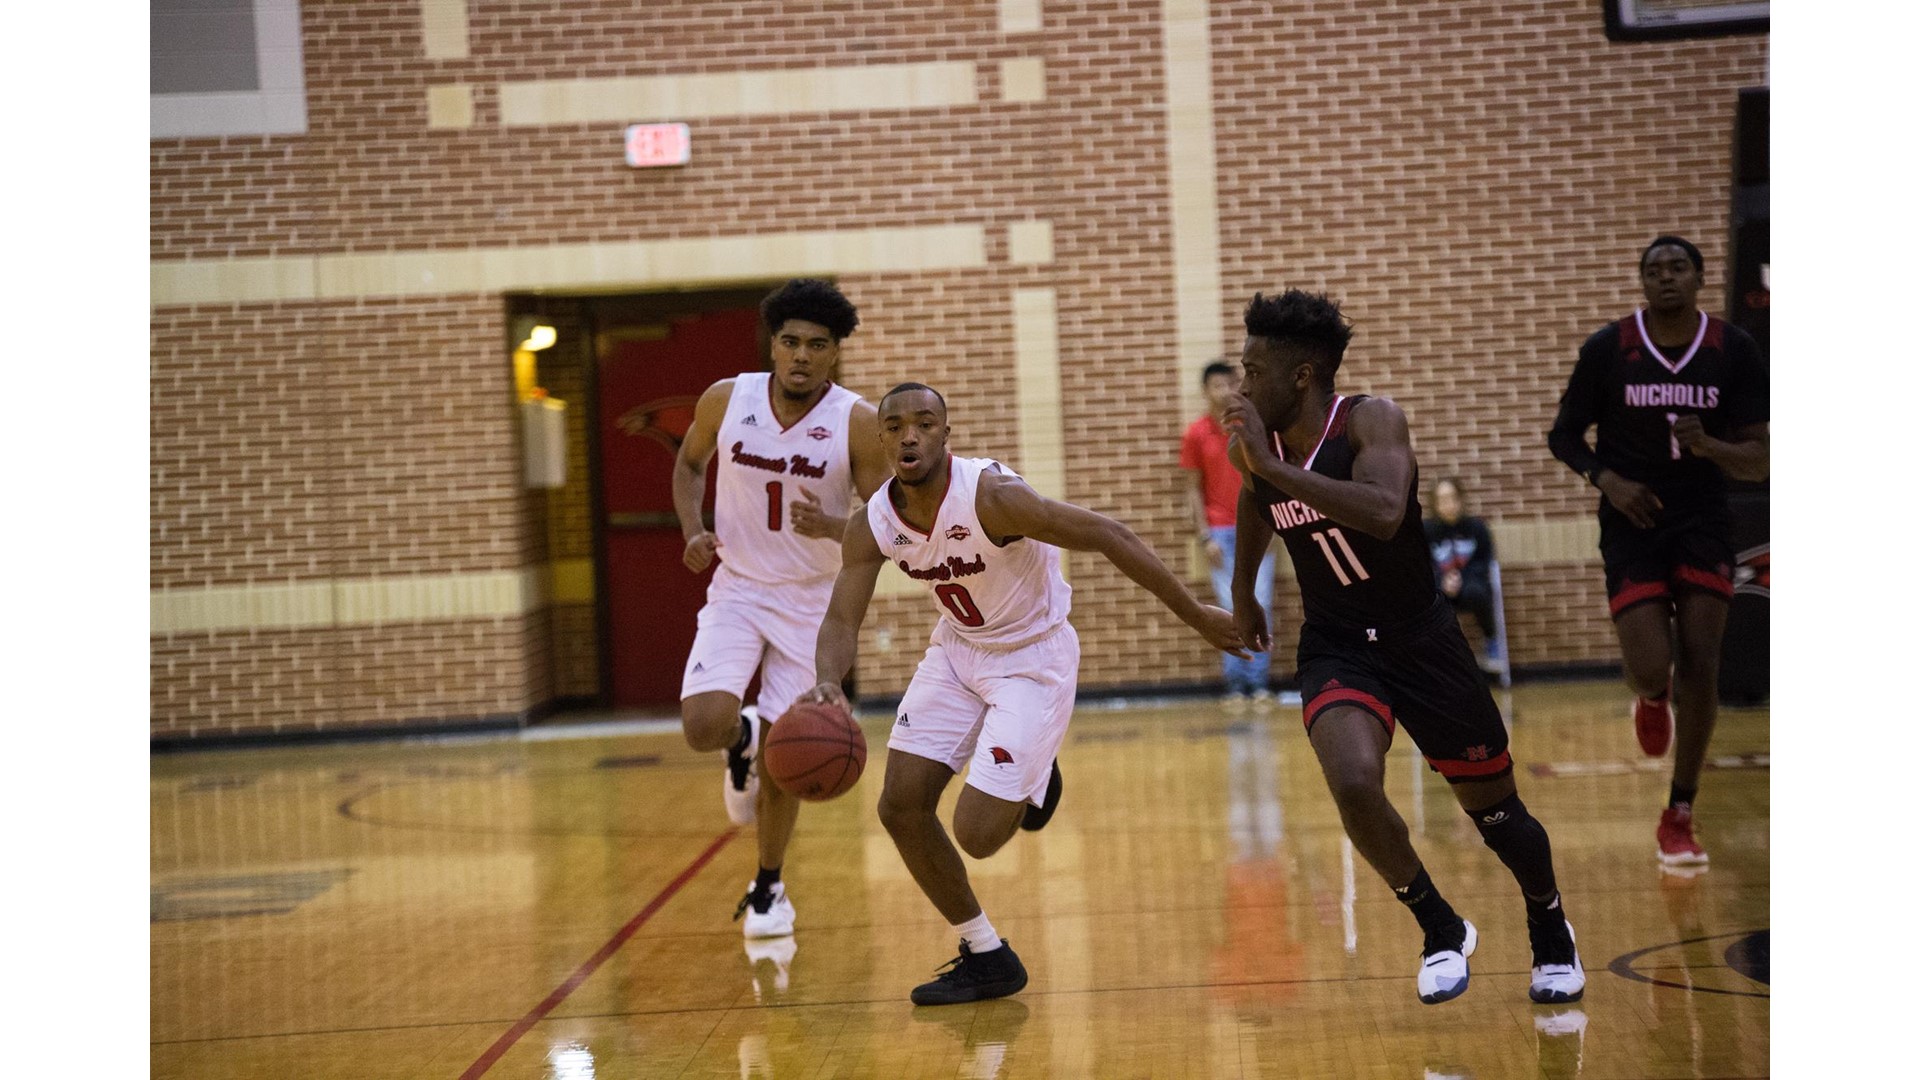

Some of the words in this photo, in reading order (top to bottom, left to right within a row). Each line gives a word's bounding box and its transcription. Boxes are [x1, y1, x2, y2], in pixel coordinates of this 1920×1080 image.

[1624, 383, 1720, 408] NICHOLLS
[790, 454, 827, 478] Word
[766, 481, 783, 532] 1
[1270, 500, 1327, 530] NICH
[1311, 527, 1370, 586] 11
[935, 583, 985, 627] 0
